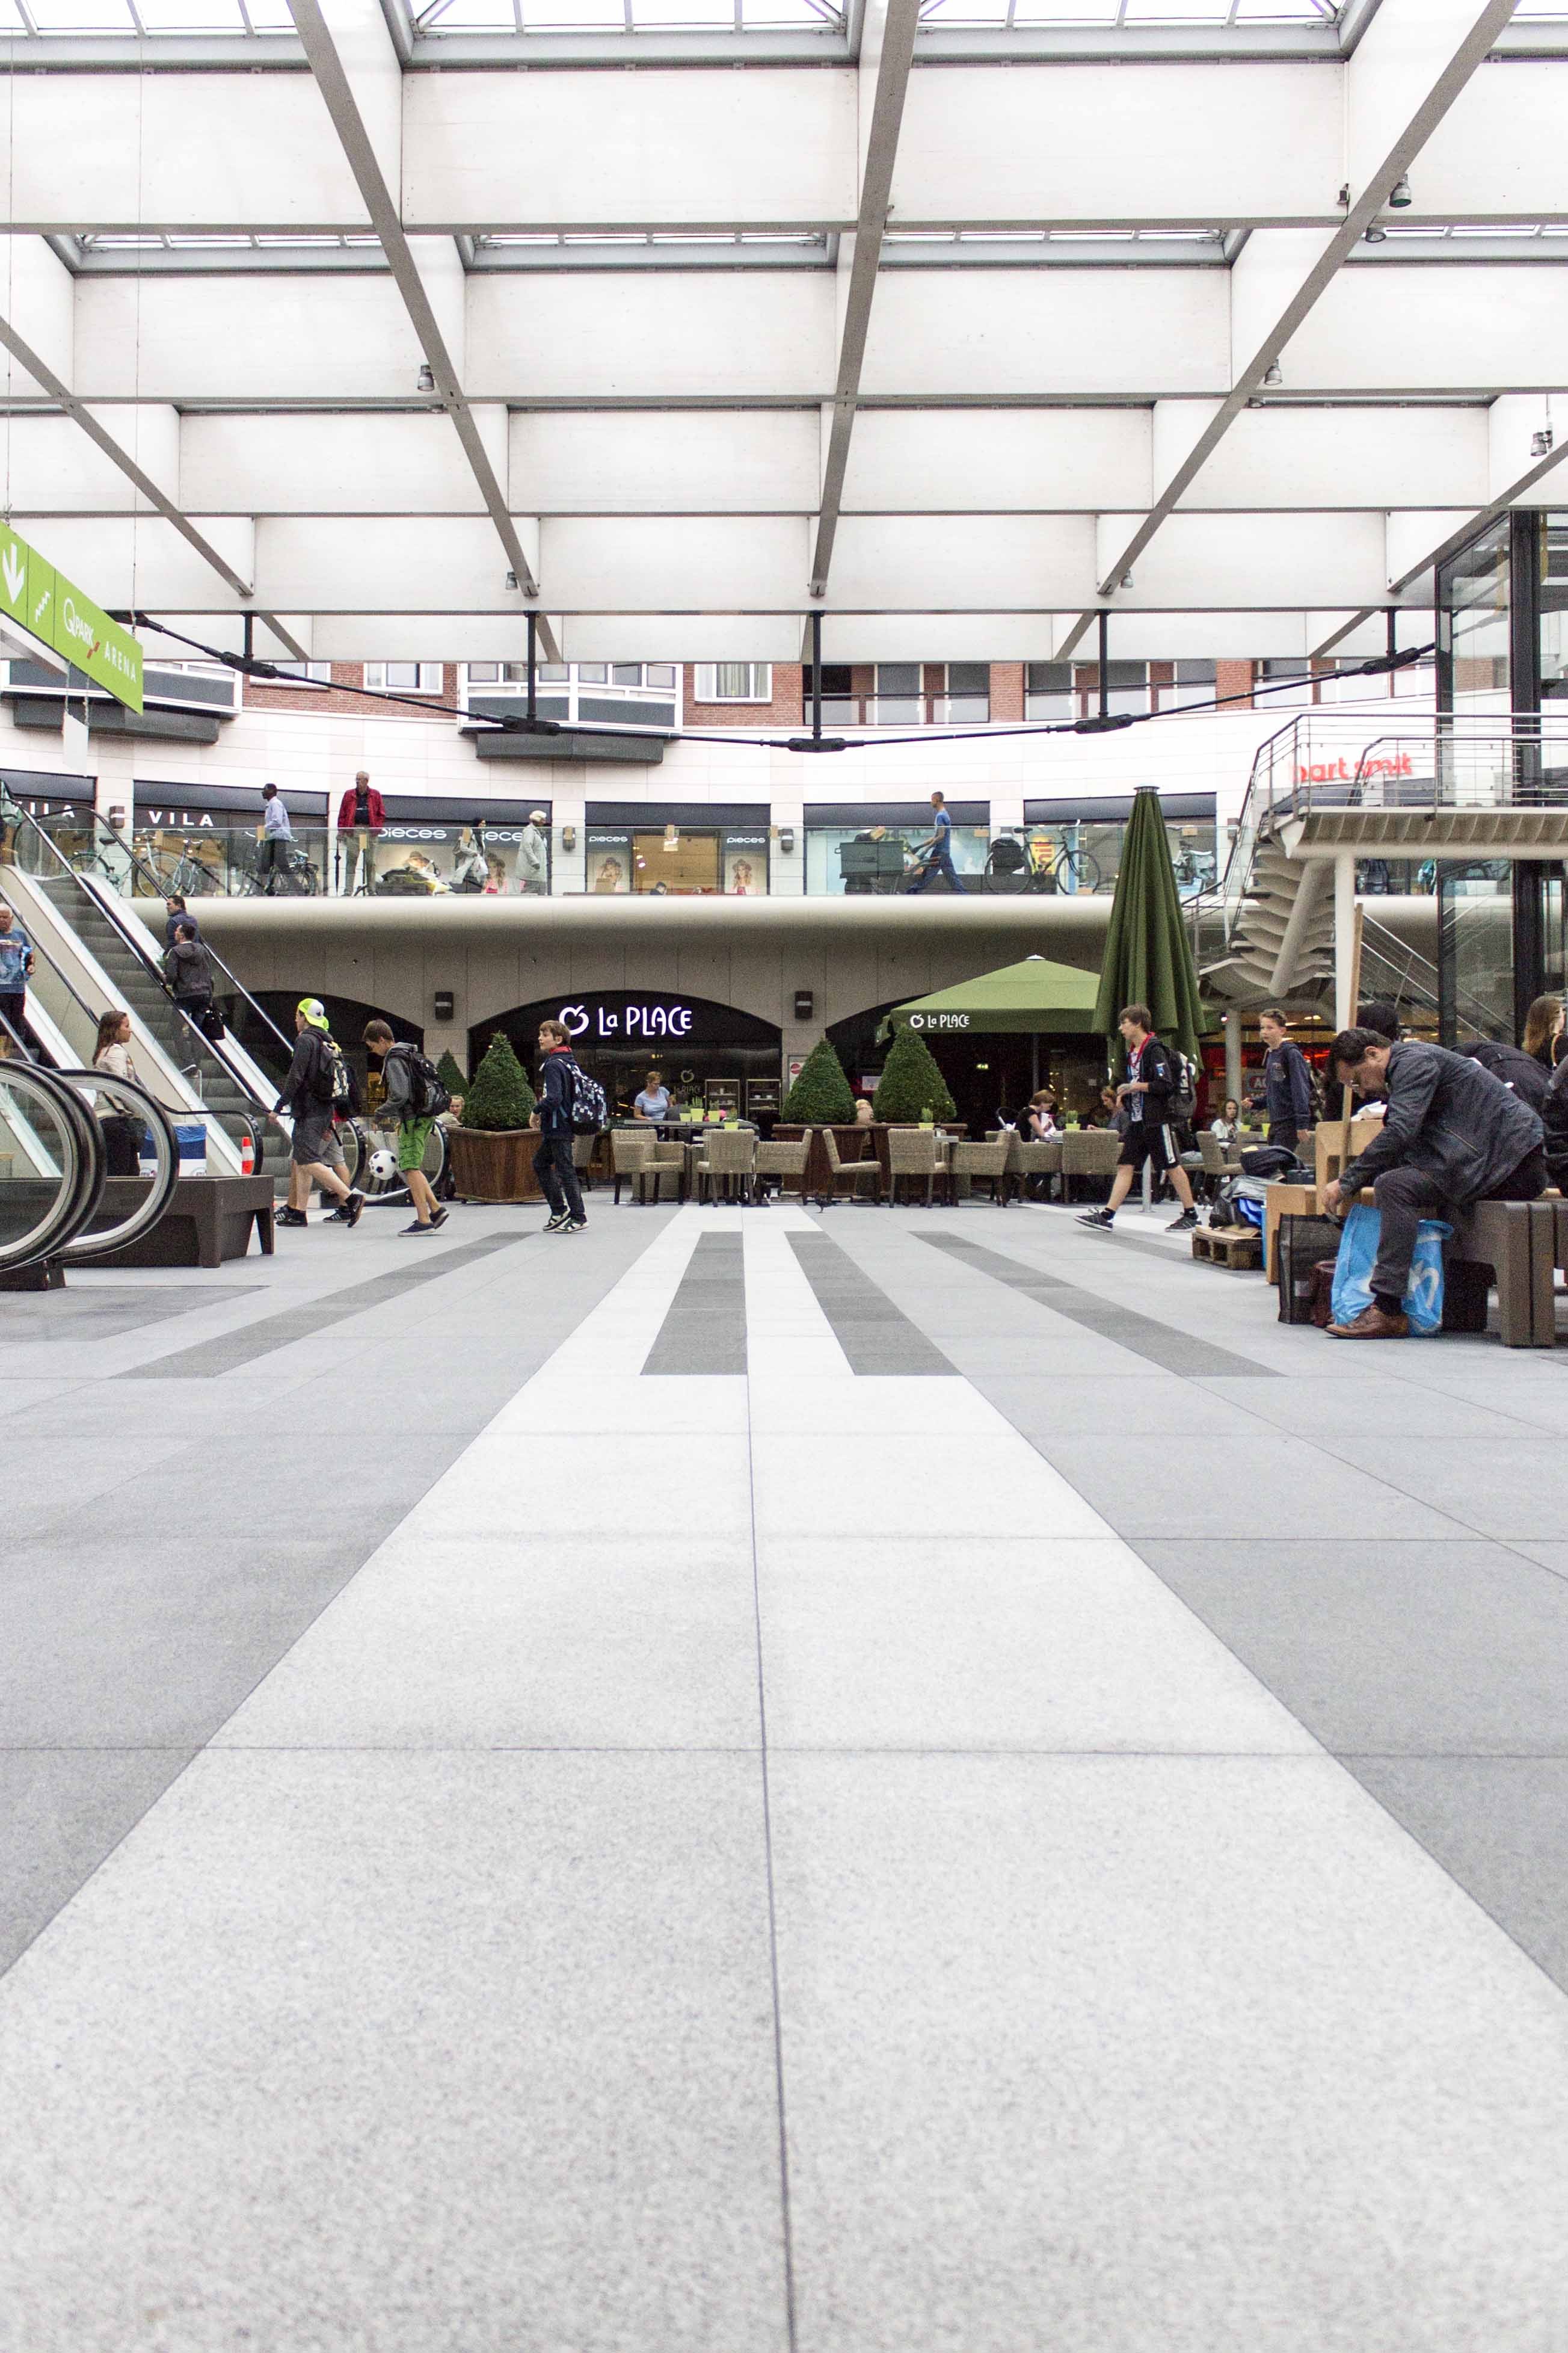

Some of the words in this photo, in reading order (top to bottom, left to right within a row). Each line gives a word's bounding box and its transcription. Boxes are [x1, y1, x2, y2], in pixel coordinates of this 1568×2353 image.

[104, 641, 137, 684] ARENA
[149, 810, 214, 827] VILA
[481, 830, 523, 842] iece
[598, 1007, 618, 1035] La
[626, 1007, 692, 1035] PLACE
[927, 1015, 937, 1028] La
[939, 1014, 970, 1028] PLACE
